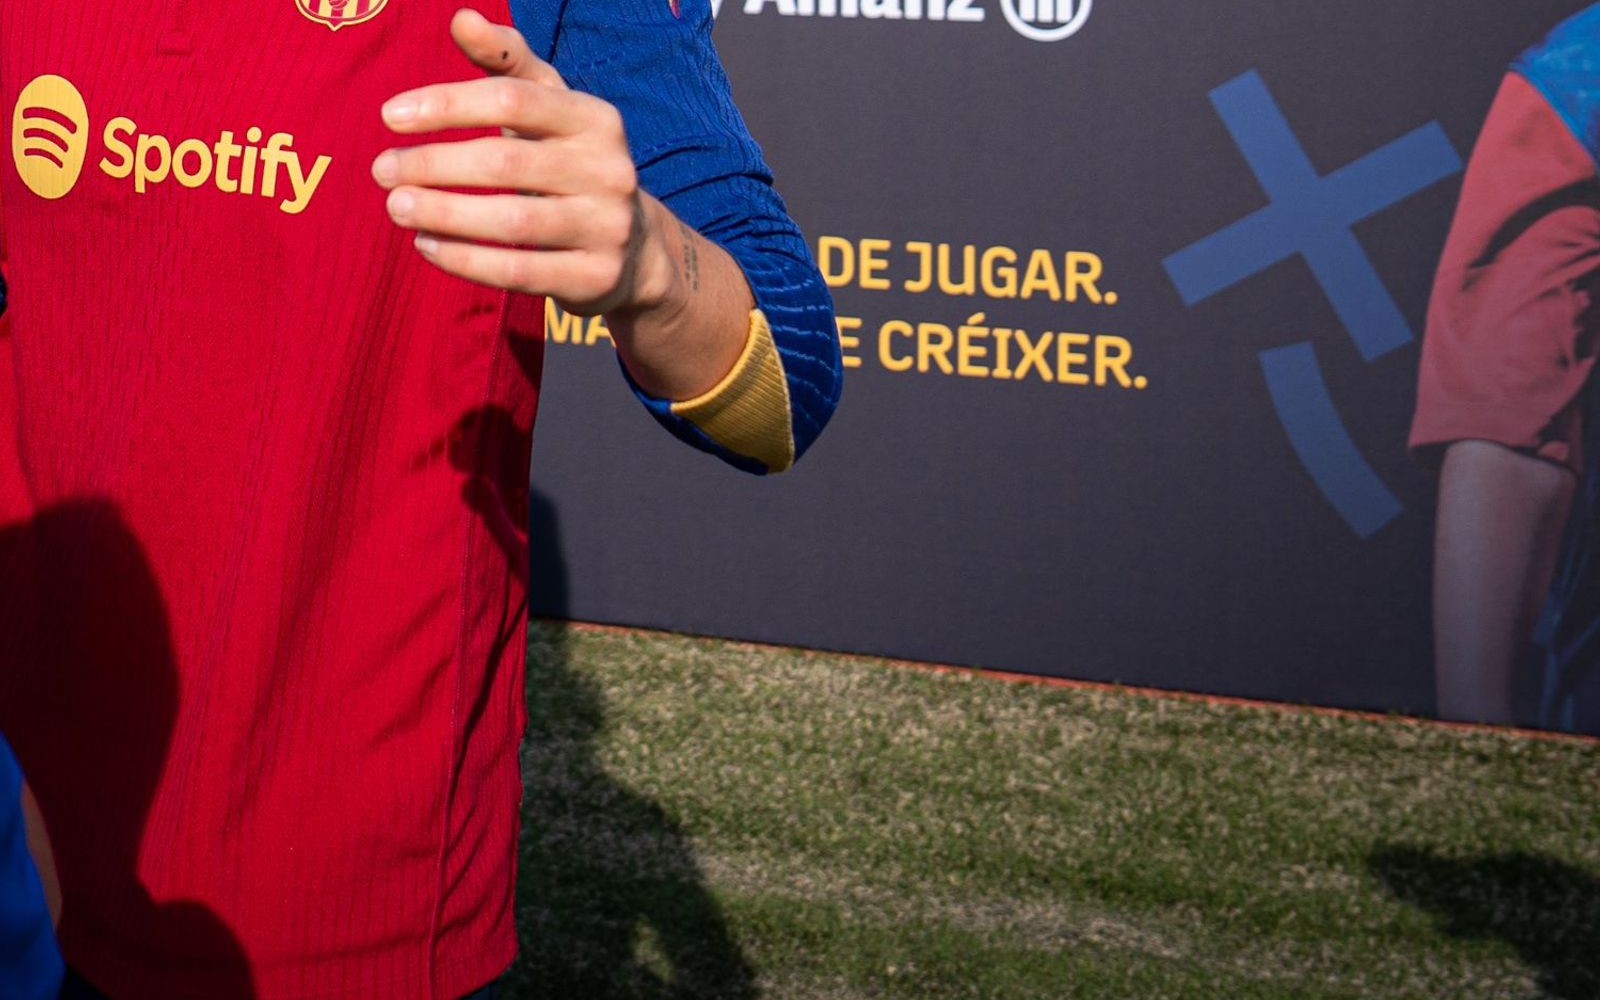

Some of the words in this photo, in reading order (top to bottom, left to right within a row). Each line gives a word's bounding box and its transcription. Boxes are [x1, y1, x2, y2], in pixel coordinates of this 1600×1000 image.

[99, 115, 333, 215] Spotify
[817, 235, 892, 291] DE
[903, 240, 1119, 306] JUGAR.
[543, 295, 618, 347] MA
[834, 315, 863, 369] E
[877, 310, 1149, 390] CRÉIXER.
